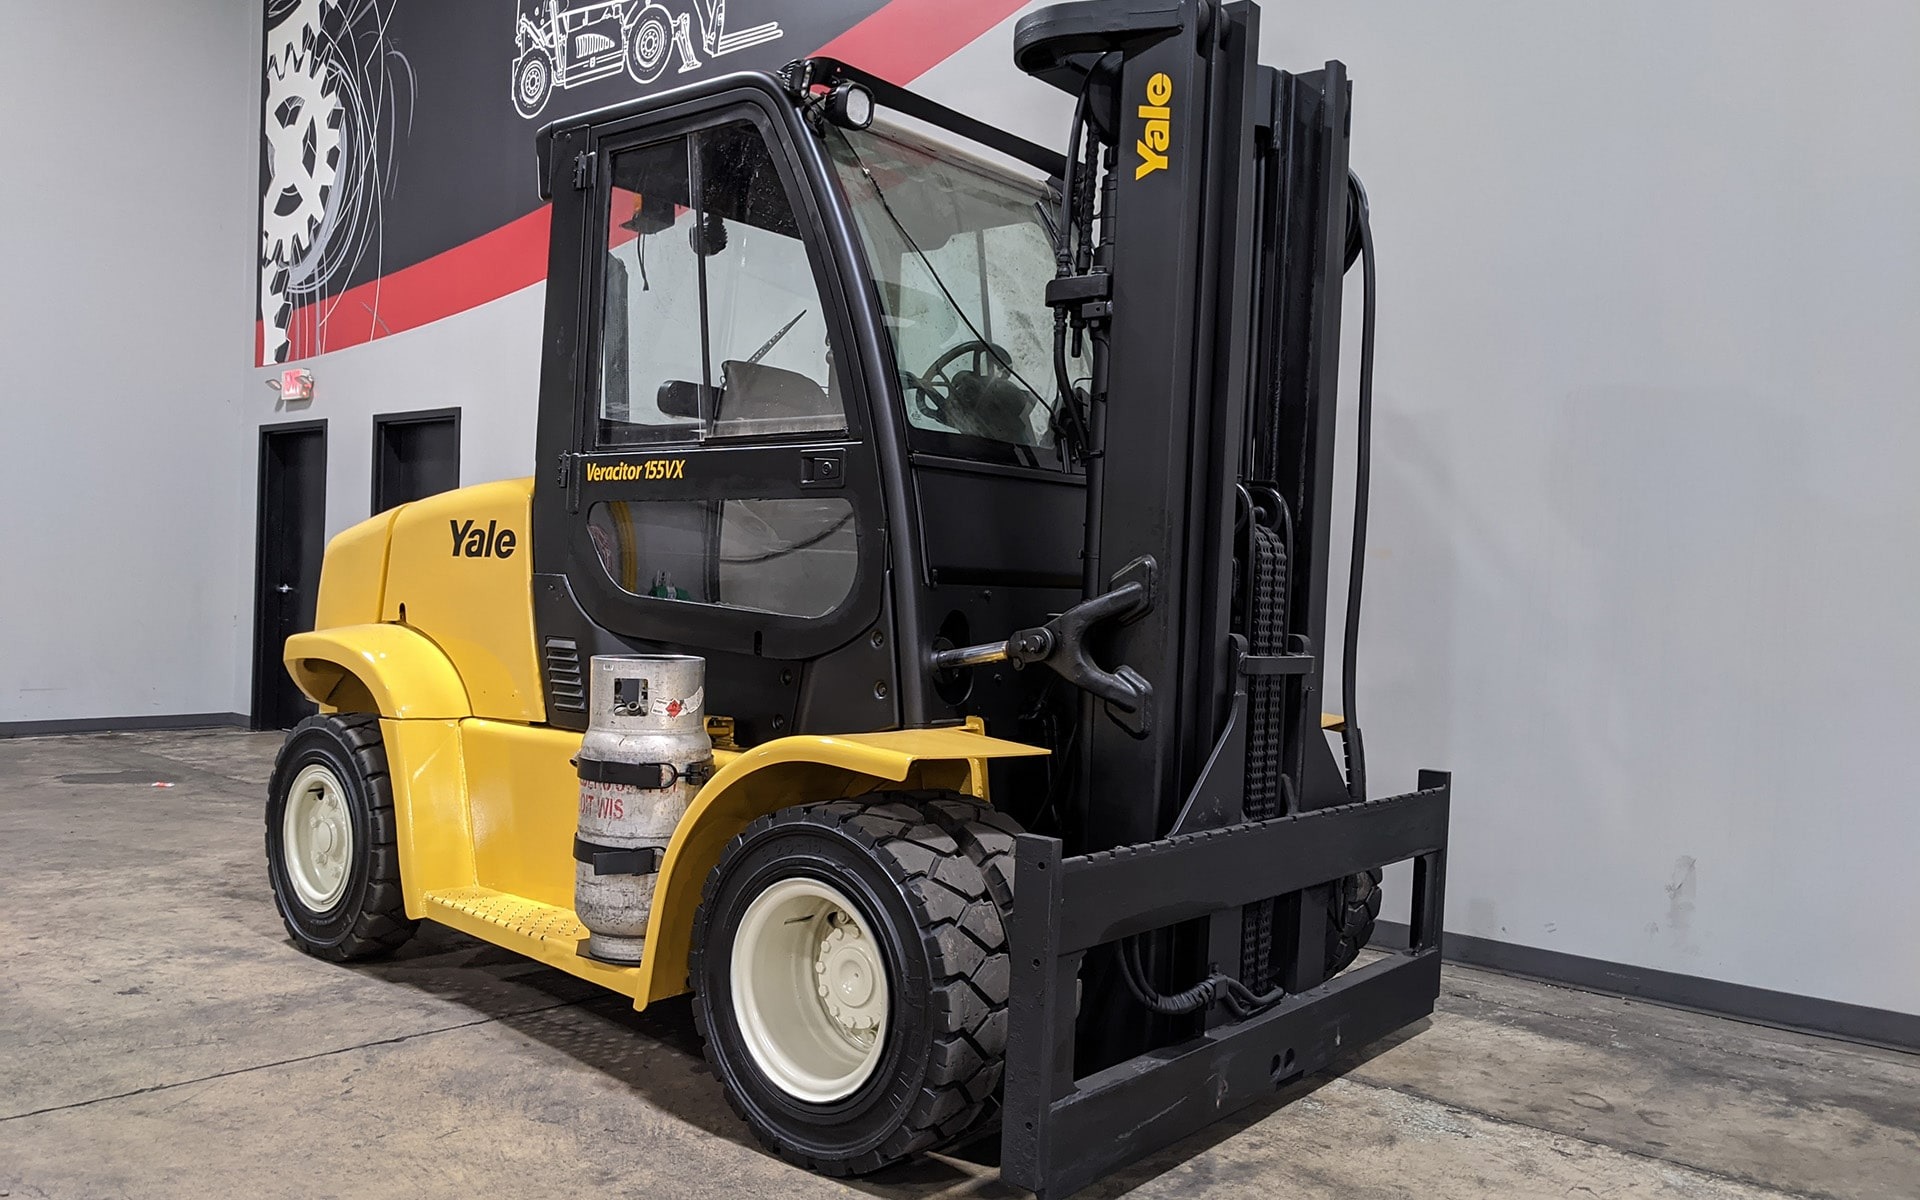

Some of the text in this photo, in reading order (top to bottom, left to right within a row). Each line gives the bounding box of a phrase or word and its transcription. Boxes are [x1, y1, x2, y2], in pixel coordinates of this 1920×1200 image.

[1136, 72, 1172, 180] Yale
[586, 460, 685, 481] Veracitor 155VX
[450, 519, 516, 559] Yale
[597, 798, 624, 819] WIS
